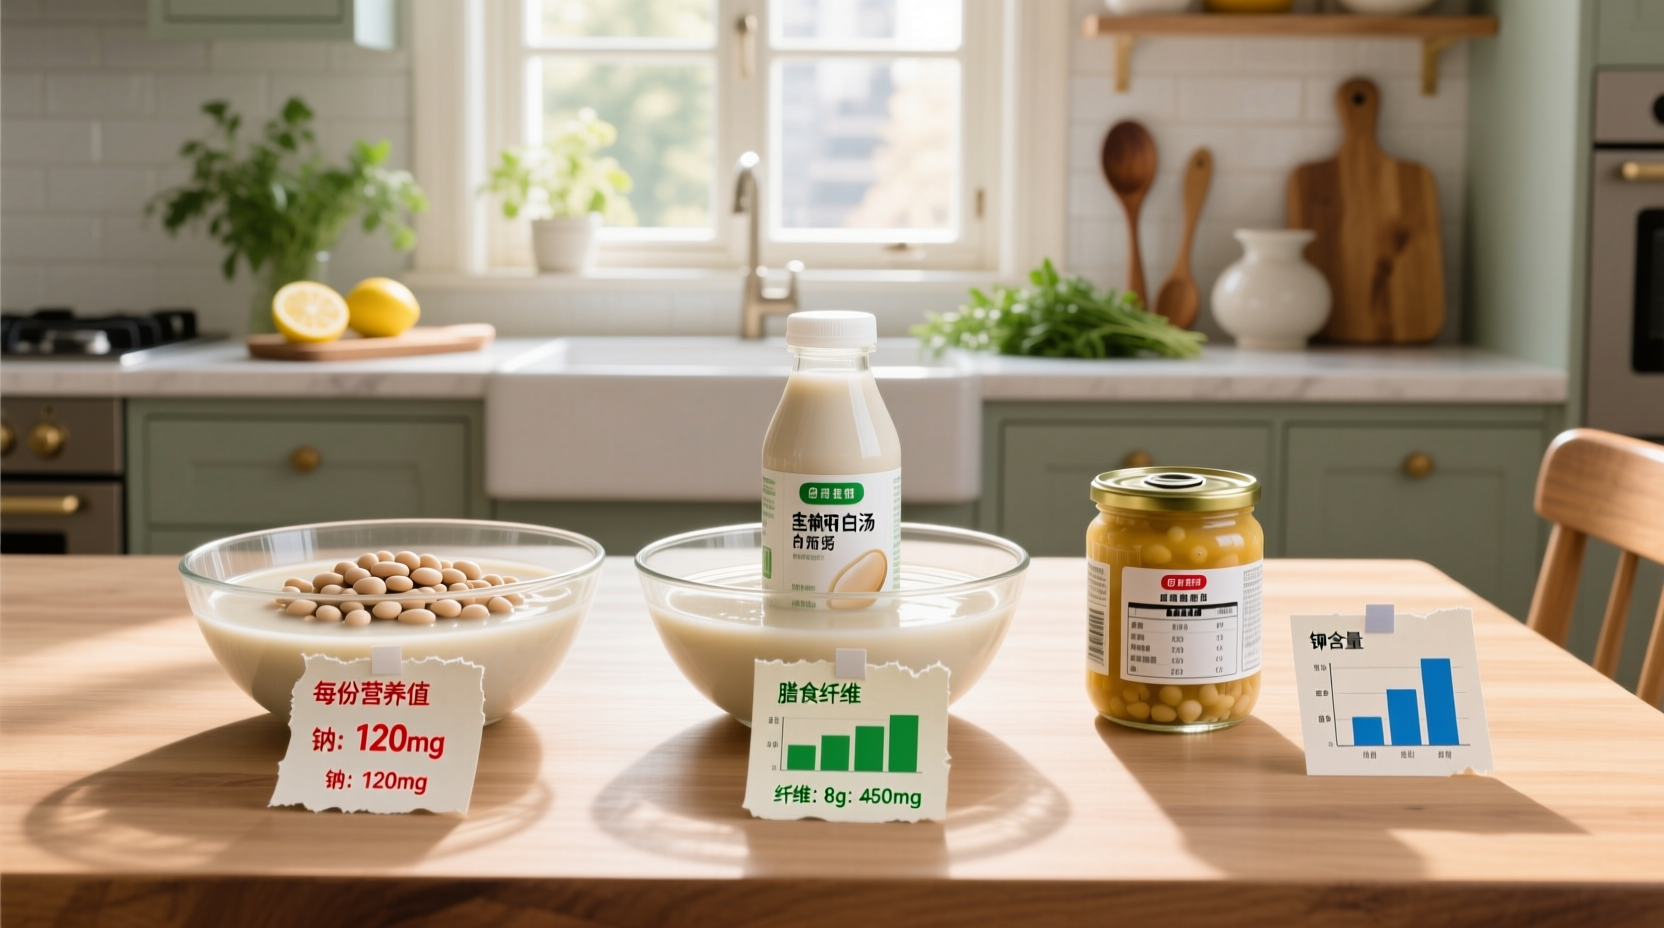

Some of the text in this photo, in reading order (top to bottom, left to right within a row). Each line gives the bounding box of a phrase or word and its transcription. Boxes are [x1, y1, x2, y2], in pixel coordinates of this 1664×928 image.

[312, 680, 431, 706] 每份营养值
[777, 681, 862, 705] 膳食纤维
[355, 723, 446, 760] 120mg
[361, 771, 428, 795] 120mg
[858, 788, 923, 809] 450mg
